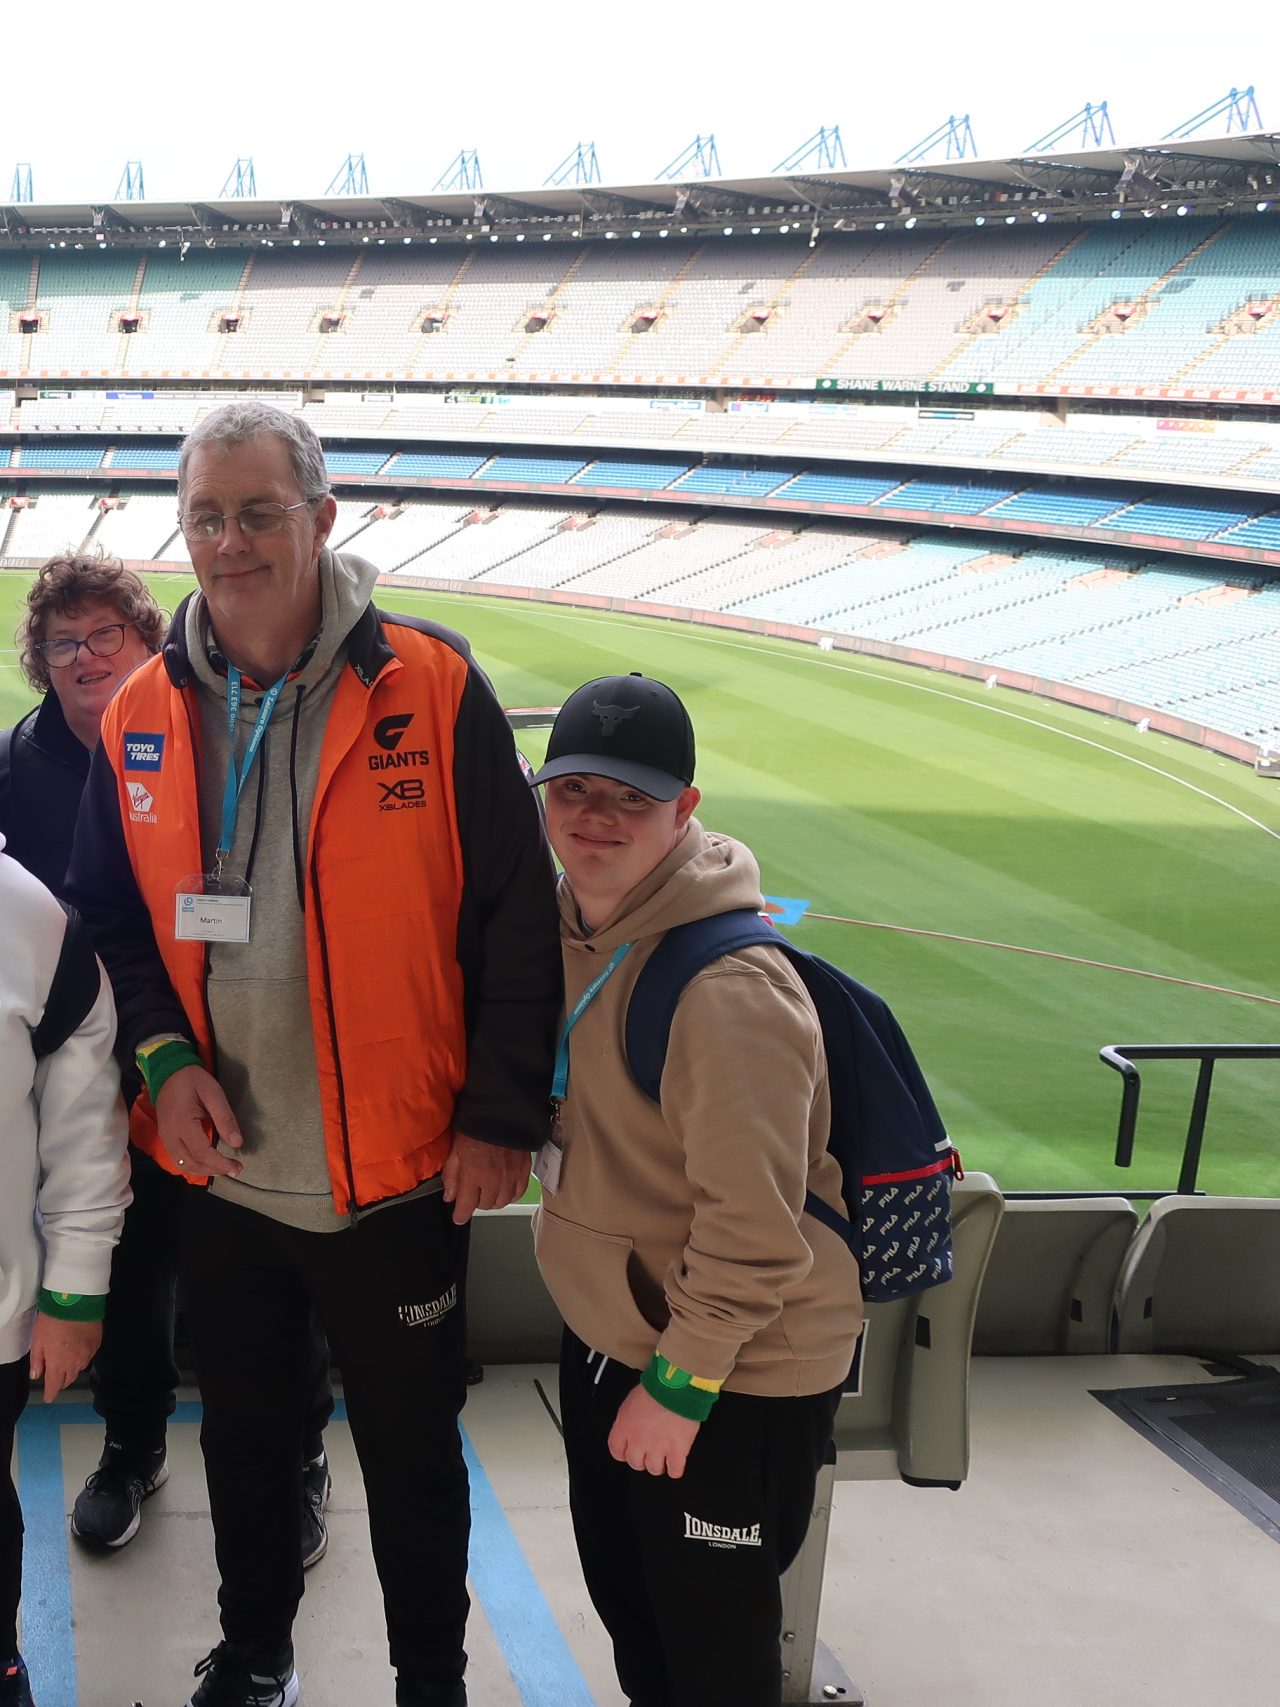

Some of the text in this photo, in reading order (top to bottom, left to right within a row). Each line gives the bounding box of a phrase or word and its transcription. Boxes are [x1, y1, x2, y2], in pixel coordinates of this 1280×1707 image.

[836, 378, 971, 393] SHANE WARNE STAND
[231, 681, 239, 695] 713
[249, 696, 274, 753] Leisure Options
[126, 743, 155, 753] TOYO
[130, 752, 160, 761] TIRES
[368, 750, 430, 771] GIANTS
[377, 778, 425, 803] XB
[378, 800, 427, 812] XBLADES
[199, 916, 223, 925] Martin
[878, 1187, 899, 1208] FILA
[904, 1185, 923, 1205] FILA
[926, 1180, 942, 1201] FILA
[880, 1214, 898, 1236] FILA
[902, 1210, 921, 1232] FILA
[924, 1207, 942, 1227] FILA
[881, 1241, 900, 1262] FILA
[907, 1236, 921, 1259] FILA
[926, 1232, 939, 1253] FILA
[880, 1267, 902, 1286] FILA
[905, 1264, 927, 1283] FILA
[931, 1257, 942, 1280] FILA
[683, 1511, 761, 1544] LONSDALE
[708, 1541, 737, 1550] LONDON
